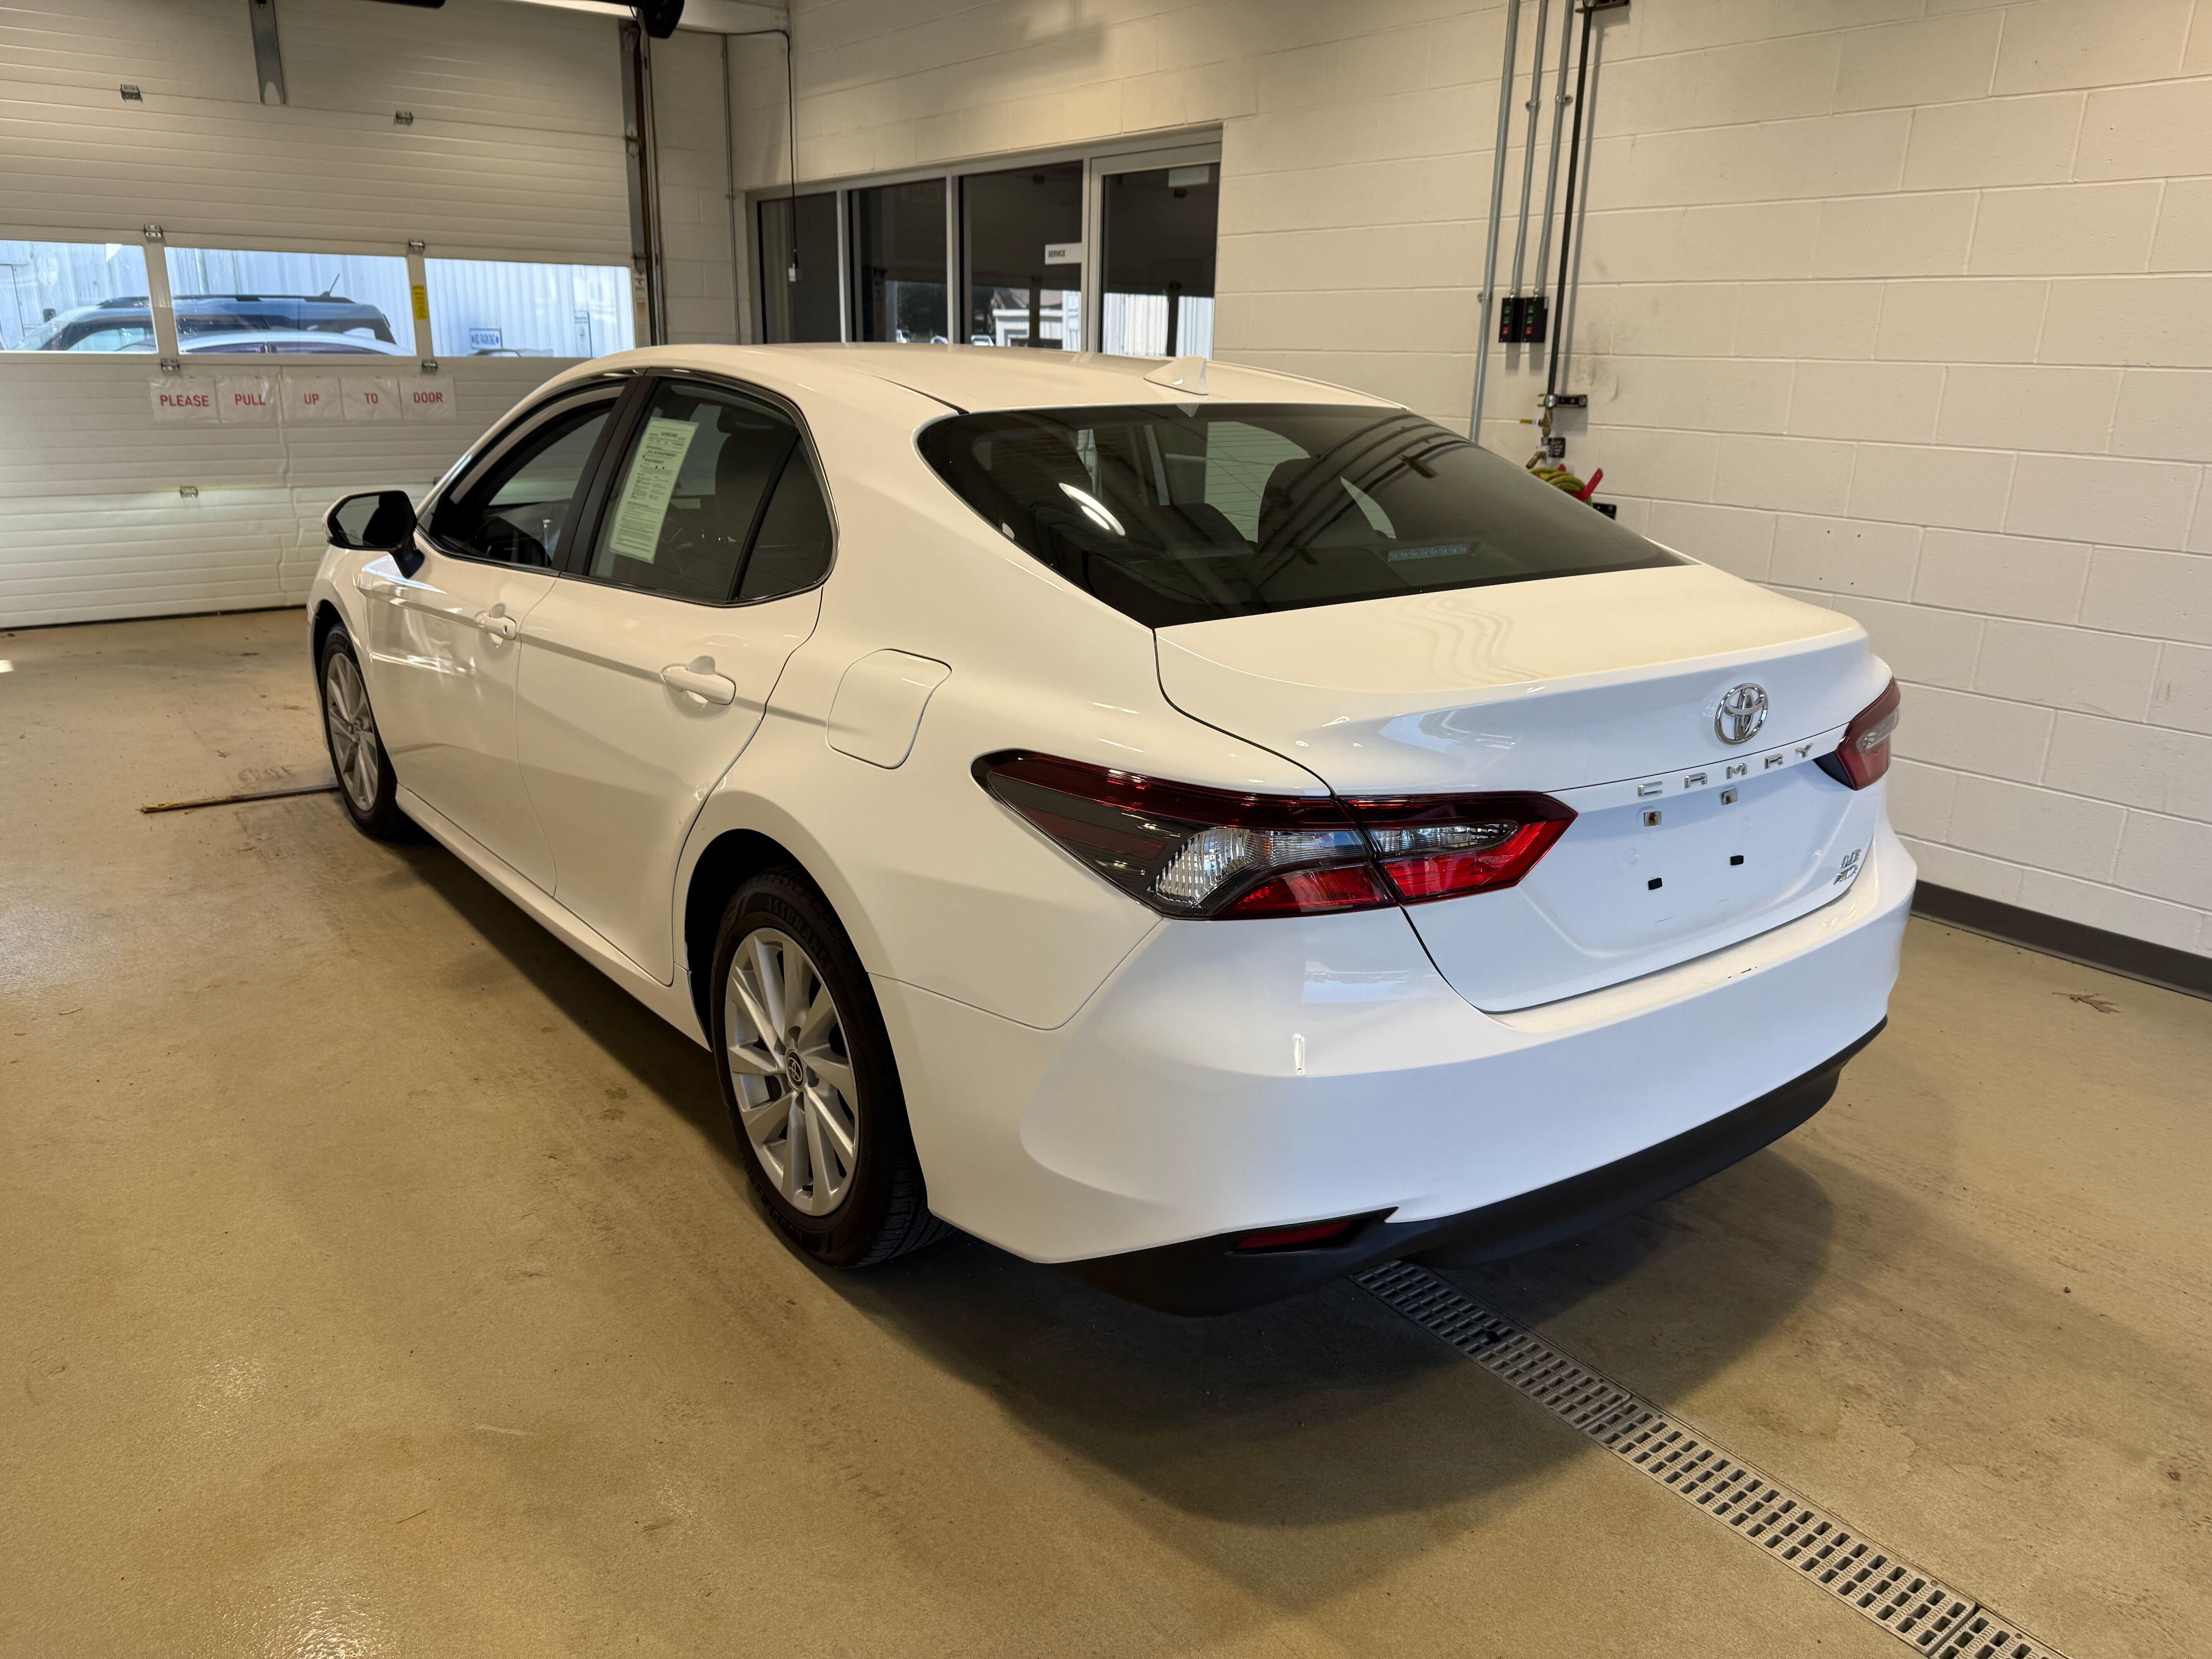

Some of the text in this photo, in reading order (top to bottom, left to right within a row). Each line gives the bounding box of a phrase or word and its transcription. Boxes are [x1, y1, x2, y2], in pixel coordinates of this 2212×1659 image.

[160, 392, 443, 407] PLEASE PULL UP TO DOOR
[1638, 743, 1813, 797] CAMRY
